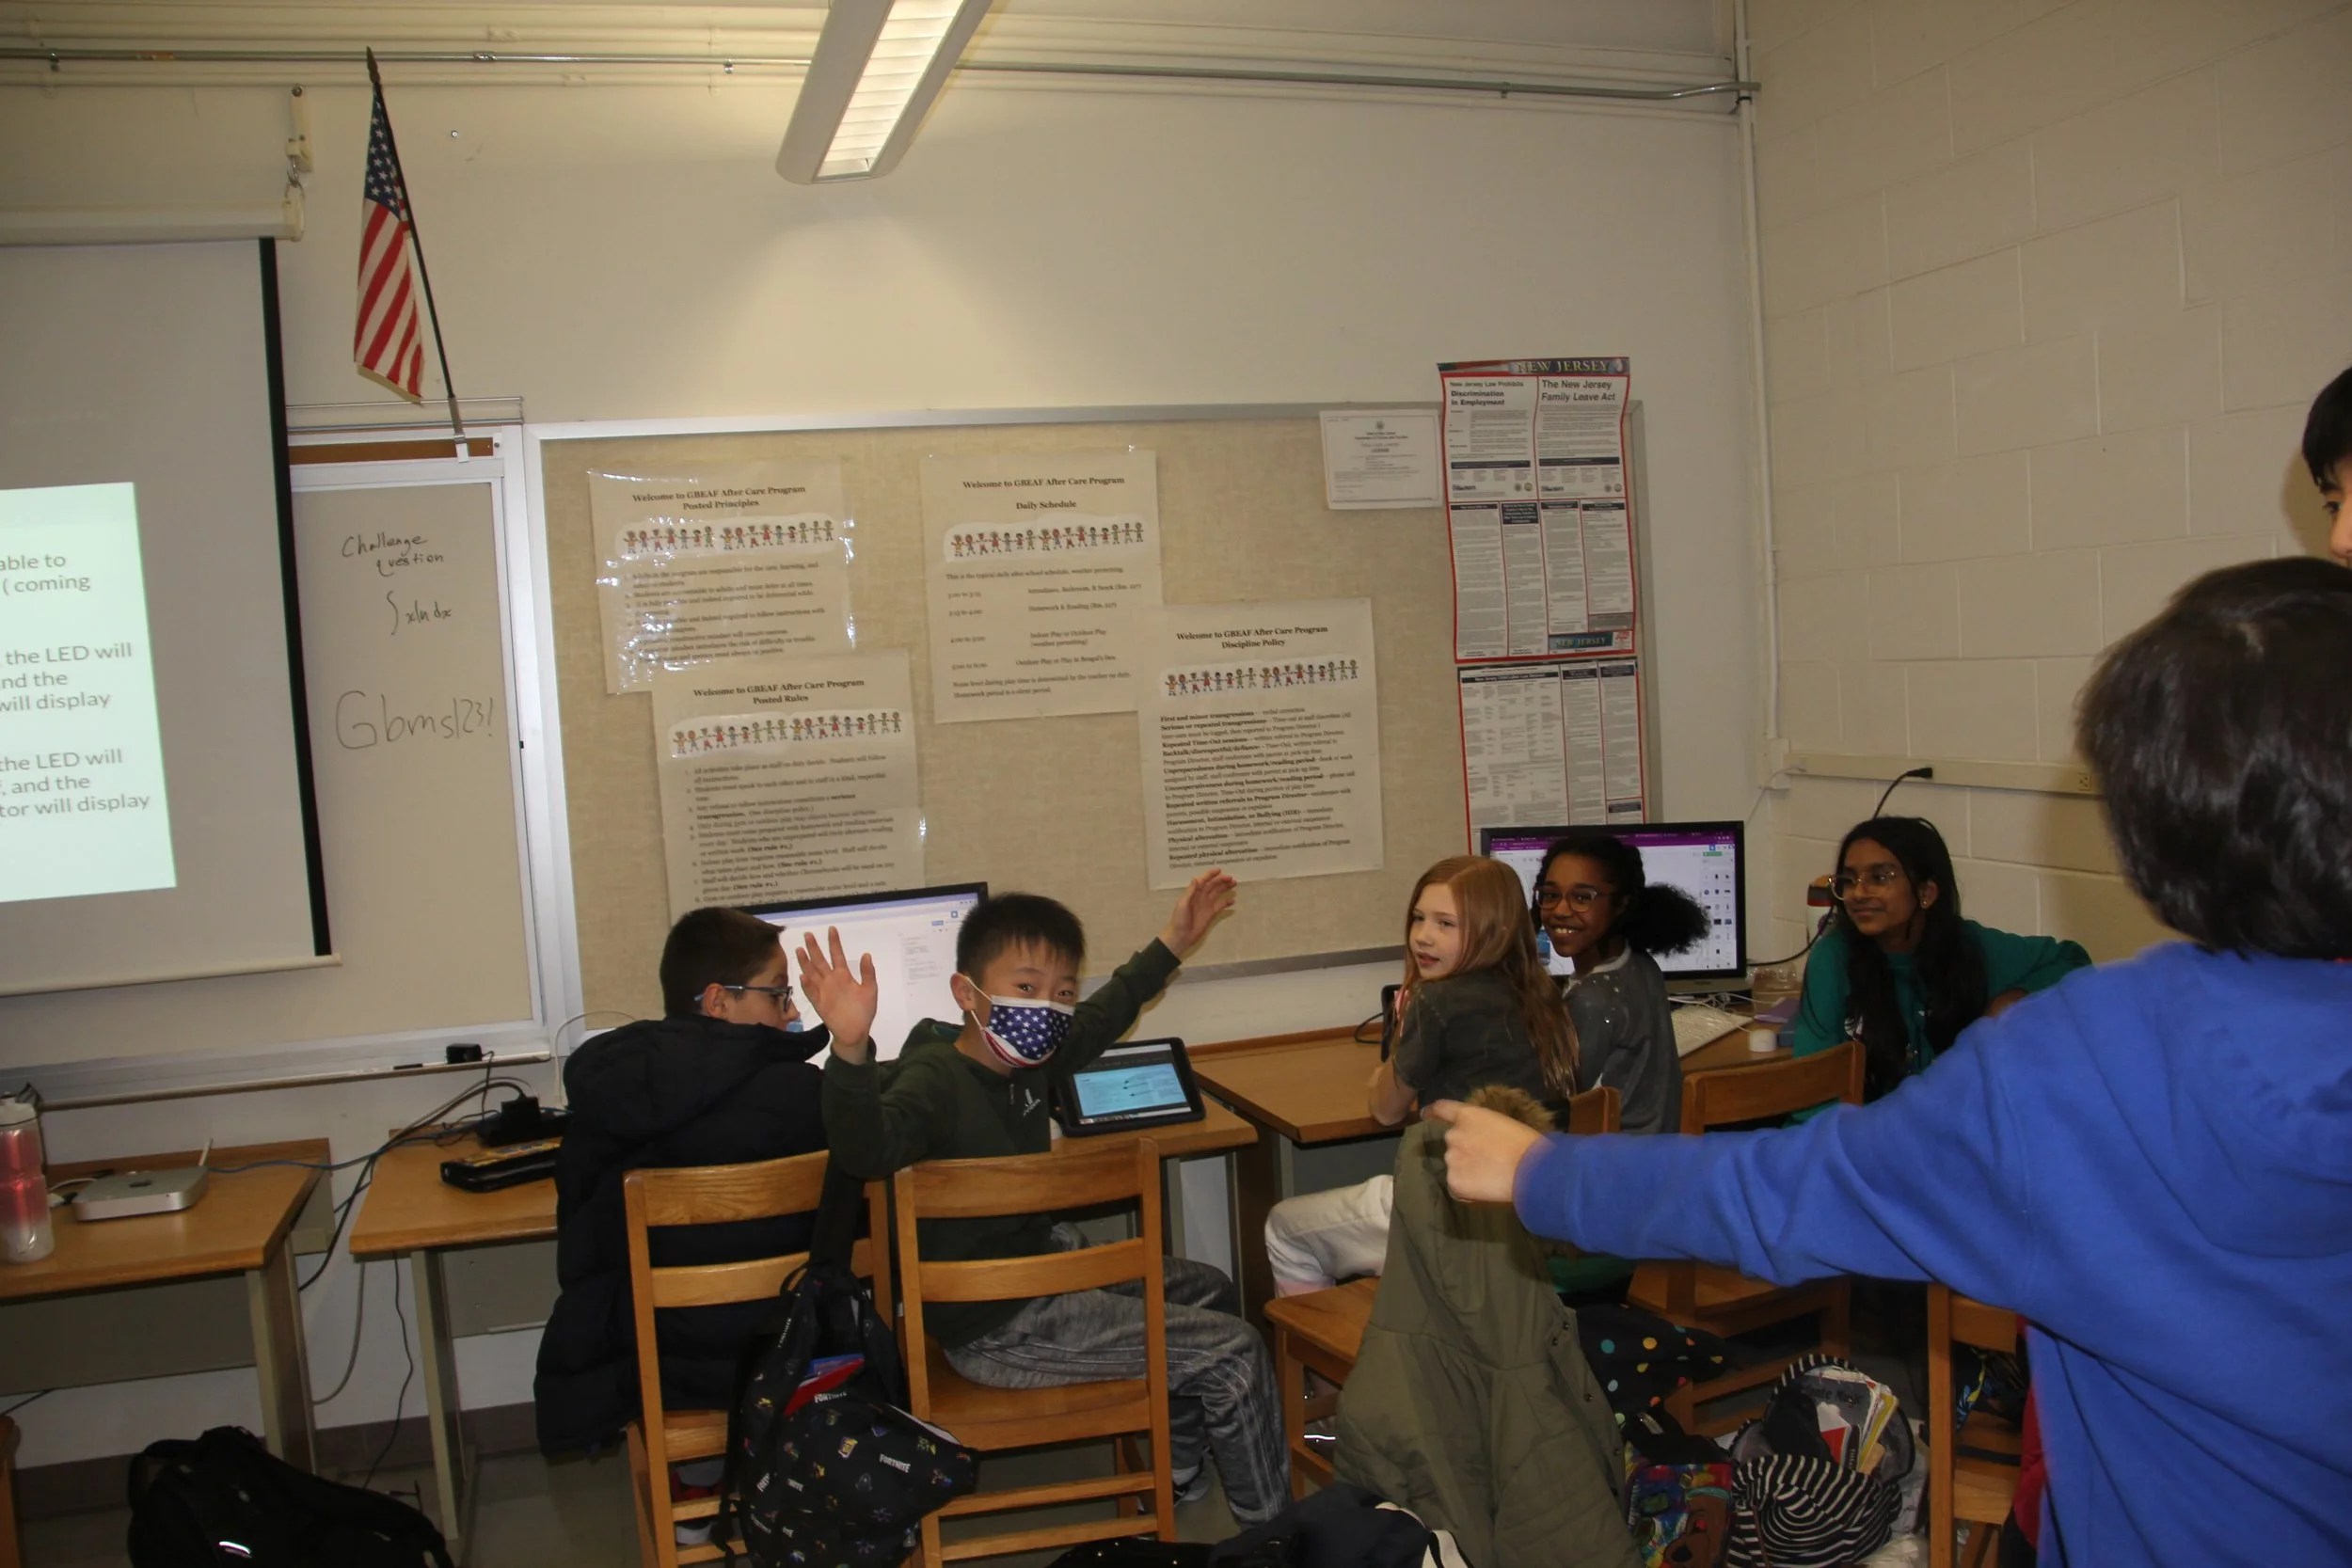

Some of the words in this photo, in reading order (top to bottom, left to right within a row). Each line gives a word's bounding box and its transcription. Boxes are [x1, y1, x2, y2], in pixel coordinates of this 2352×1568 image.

[1518, 361, 1552, 373] NEW
[1555, 360, 1610, 372] JERSEY
[1542, 379, 1559, 388] The
[1561, 379, 1580, 388] New
[1582, 379, 1613, 390] Jersey
[1541, 392, 1570, 404] Family
[1573, 392, 1598, 402] Leave
[1601, 392, 1615, 401] Act
[963, 480, 1002, 489] Welcome
[1045, 478, 1066, 486] After
[1068, 477, 1087, 486] Care
[1089, 476, 1125, 486] Program
[632, 494, 675, 502] Welcome
[722, 488, 743, 498] After
[745, 486, 766, 496] Care
[768, 485, 806, 496] Program
[683, 501, 712, 511] Posted
[715, 499, 759, 510] Principles
[1016, 501, 1037, 511] Daily
[1040, 499, 1076, 510] Schedule
[342, 531, 428, 558] Challenge
[44, 554, 67, 568] to
[14, 575, 91, 593] coming
[1176, 632, 1213, 641] Welcome
[1253, 627, 1274, 637] After
[1275, 626, 1294, 636] Care
[1295, 625, 1328, 636] Program
[1221, 640, 1262, 650] Discipline
[1263, 638, 1286, 648] Policy
[6, 650, 40, 666] the
[46, 645, 90, 662] LED
[95, 642, 132, 658] will
[0, 673, 27, 689] nd
[33, 672, 69, 687] the
[693, 688, 735, 697] Welcome
[780, 683, 803, 692] After
[804, 681, 825, 690] Care
[827, 679, 865, 689] Program
[36, 691, 111, 711] display
[753, 695, 783, 705] Posted
[785, 693, 809, 703] Rules
[36, 752, 81, 769] LED
[86, 749, 123, 766] will
[11, 776, 50, 795] and
[56, 775, 90, 791] the
[34, 798, 72, 816] will
[77, 794, 151, 813] display
[880, 1453, 911, 1474] FORTNITE
